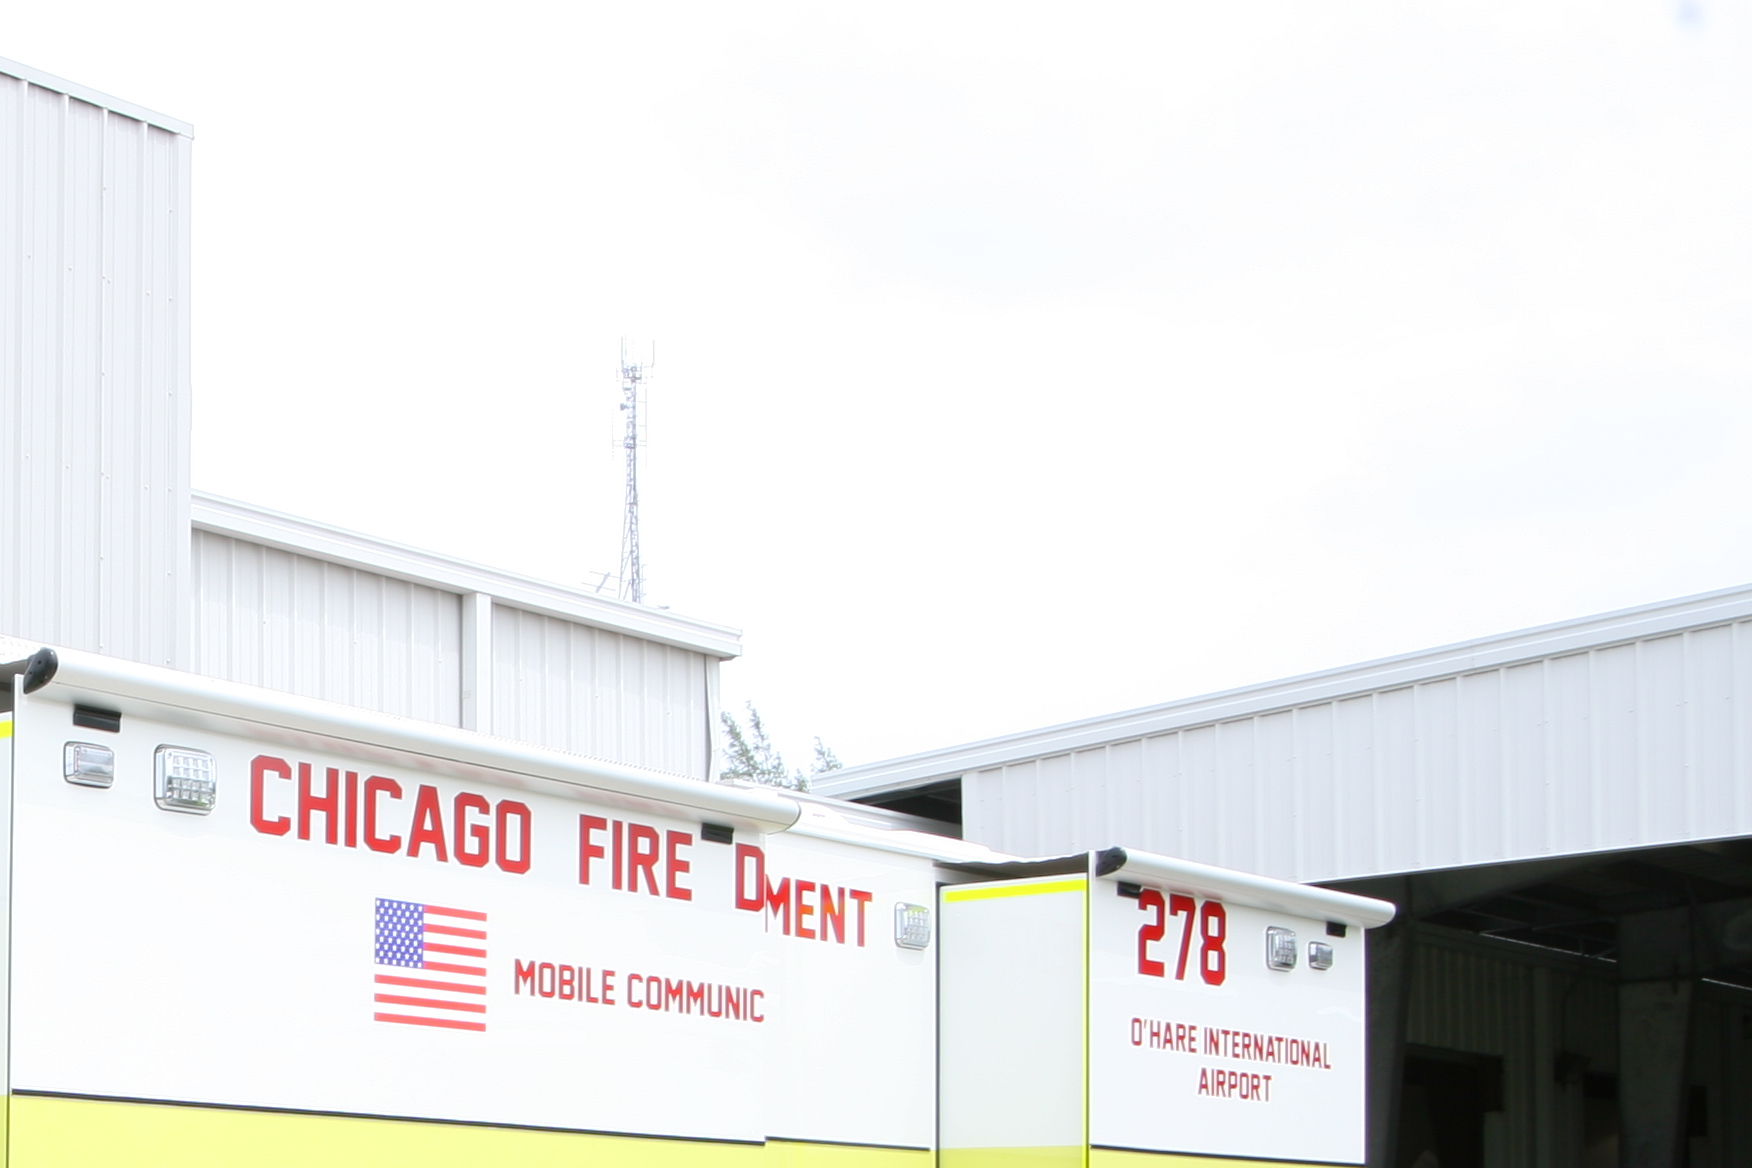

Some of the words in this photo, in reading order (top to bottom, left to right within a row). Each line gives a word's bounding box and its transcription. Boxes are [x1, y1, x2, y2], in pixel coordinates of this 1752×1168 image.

[249, 754, 531, 875] CHICAGO
[578, 813, 693, 902] FIRE
[1137, 887, 1227, 987] 278
[514, 958, 616, 1006] MOBILE
[627, 972, 765, 1023] COMMUNIC
[1131, 1017, 1198, 1054] O'HARE
[1203, 1027, 1332, 1070] INTERNATIONAL
[1198, 1067, 1272, 1102] AIRPORT
